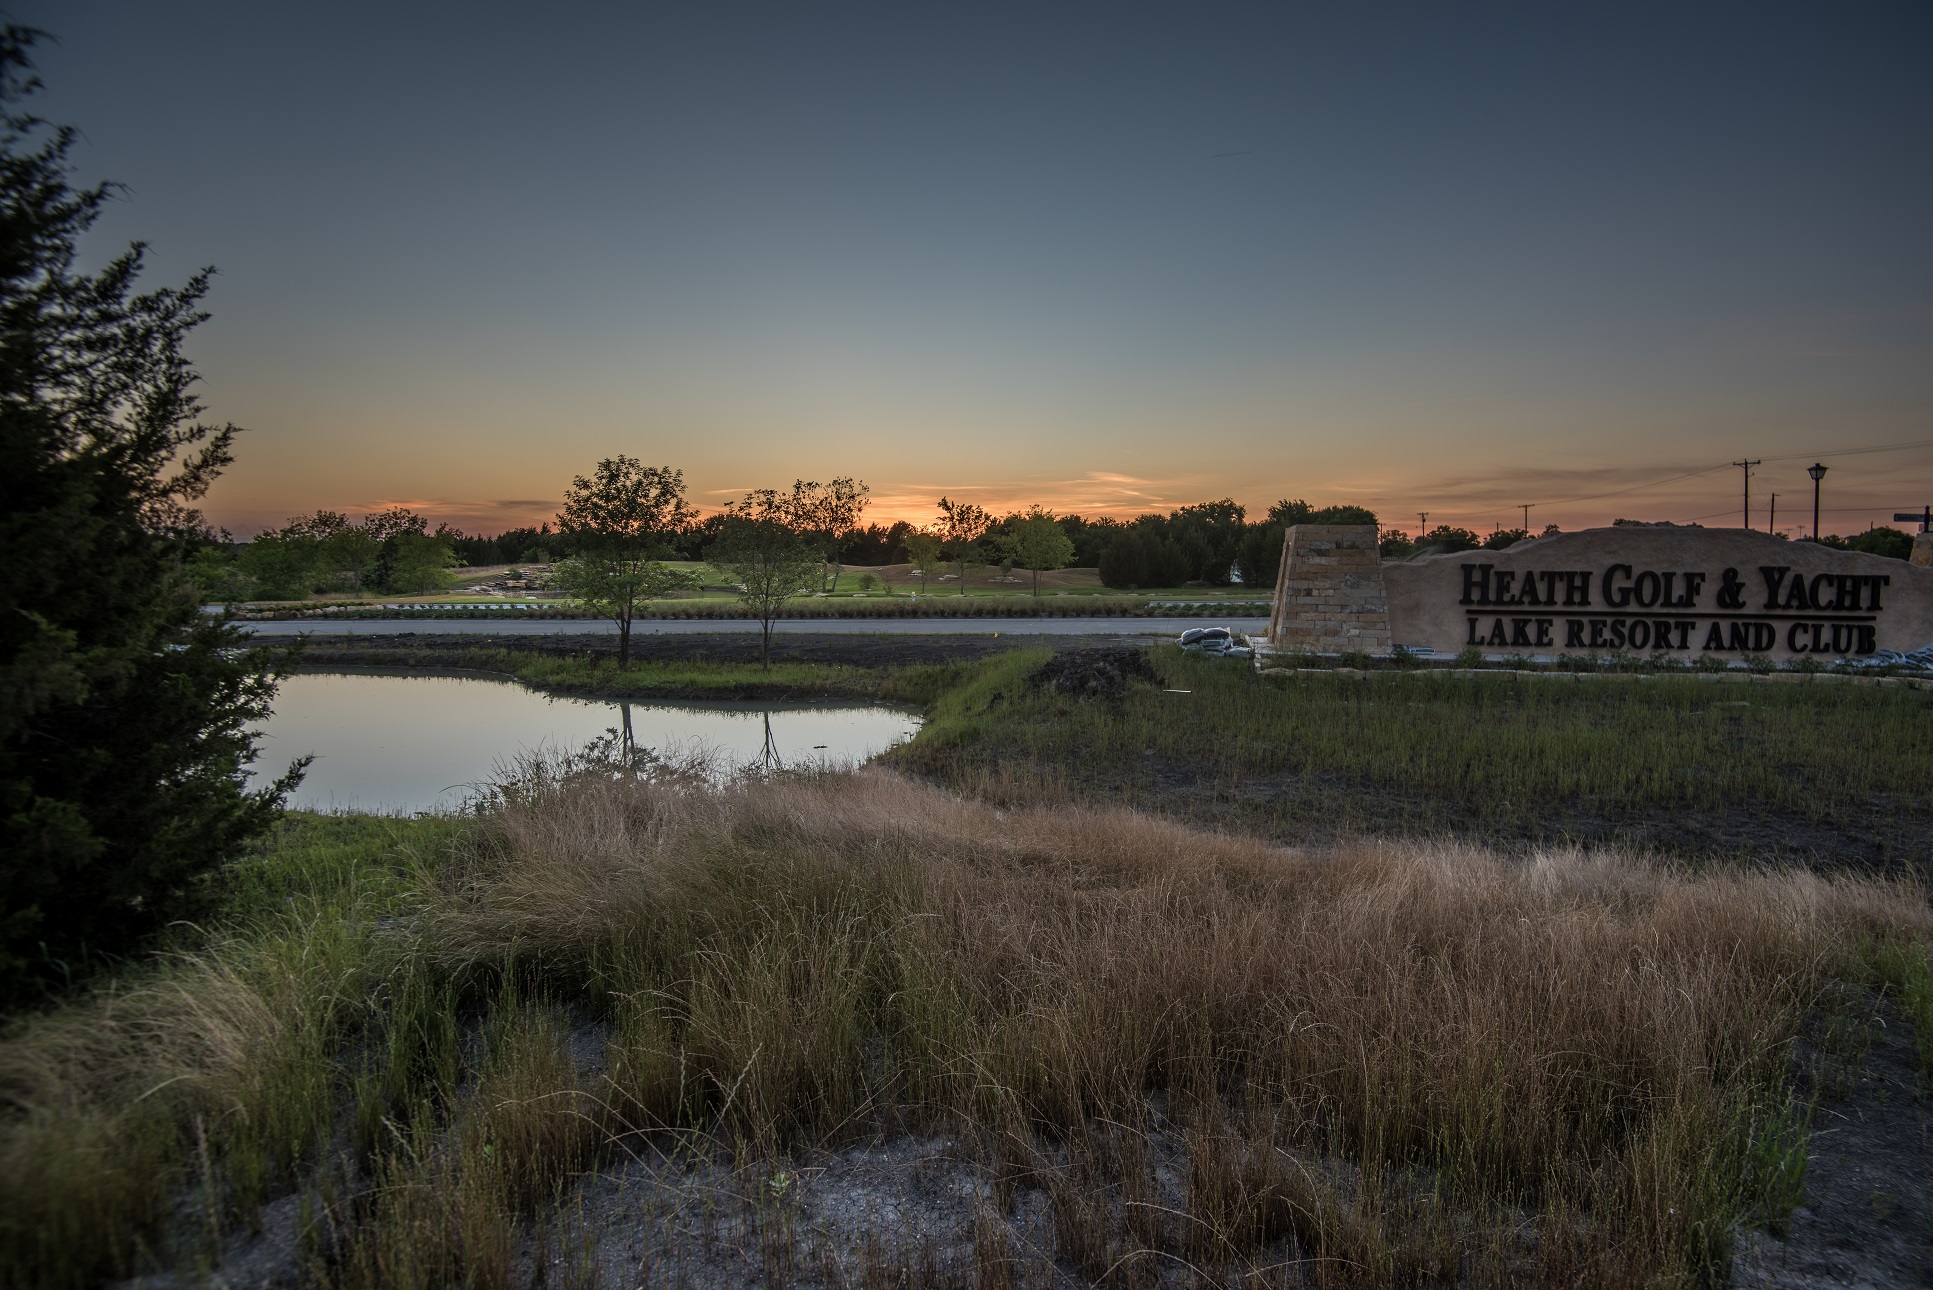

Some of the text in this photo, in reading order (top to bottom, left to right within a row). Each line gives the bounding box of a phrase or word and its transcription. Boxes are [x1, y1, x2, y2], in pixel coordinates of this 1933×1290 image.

[1459, 563, 1891, 612] HEATH GOLF & YACHT
[1466, 617, 1877, 655] LAKE RESORT AND CLUB
